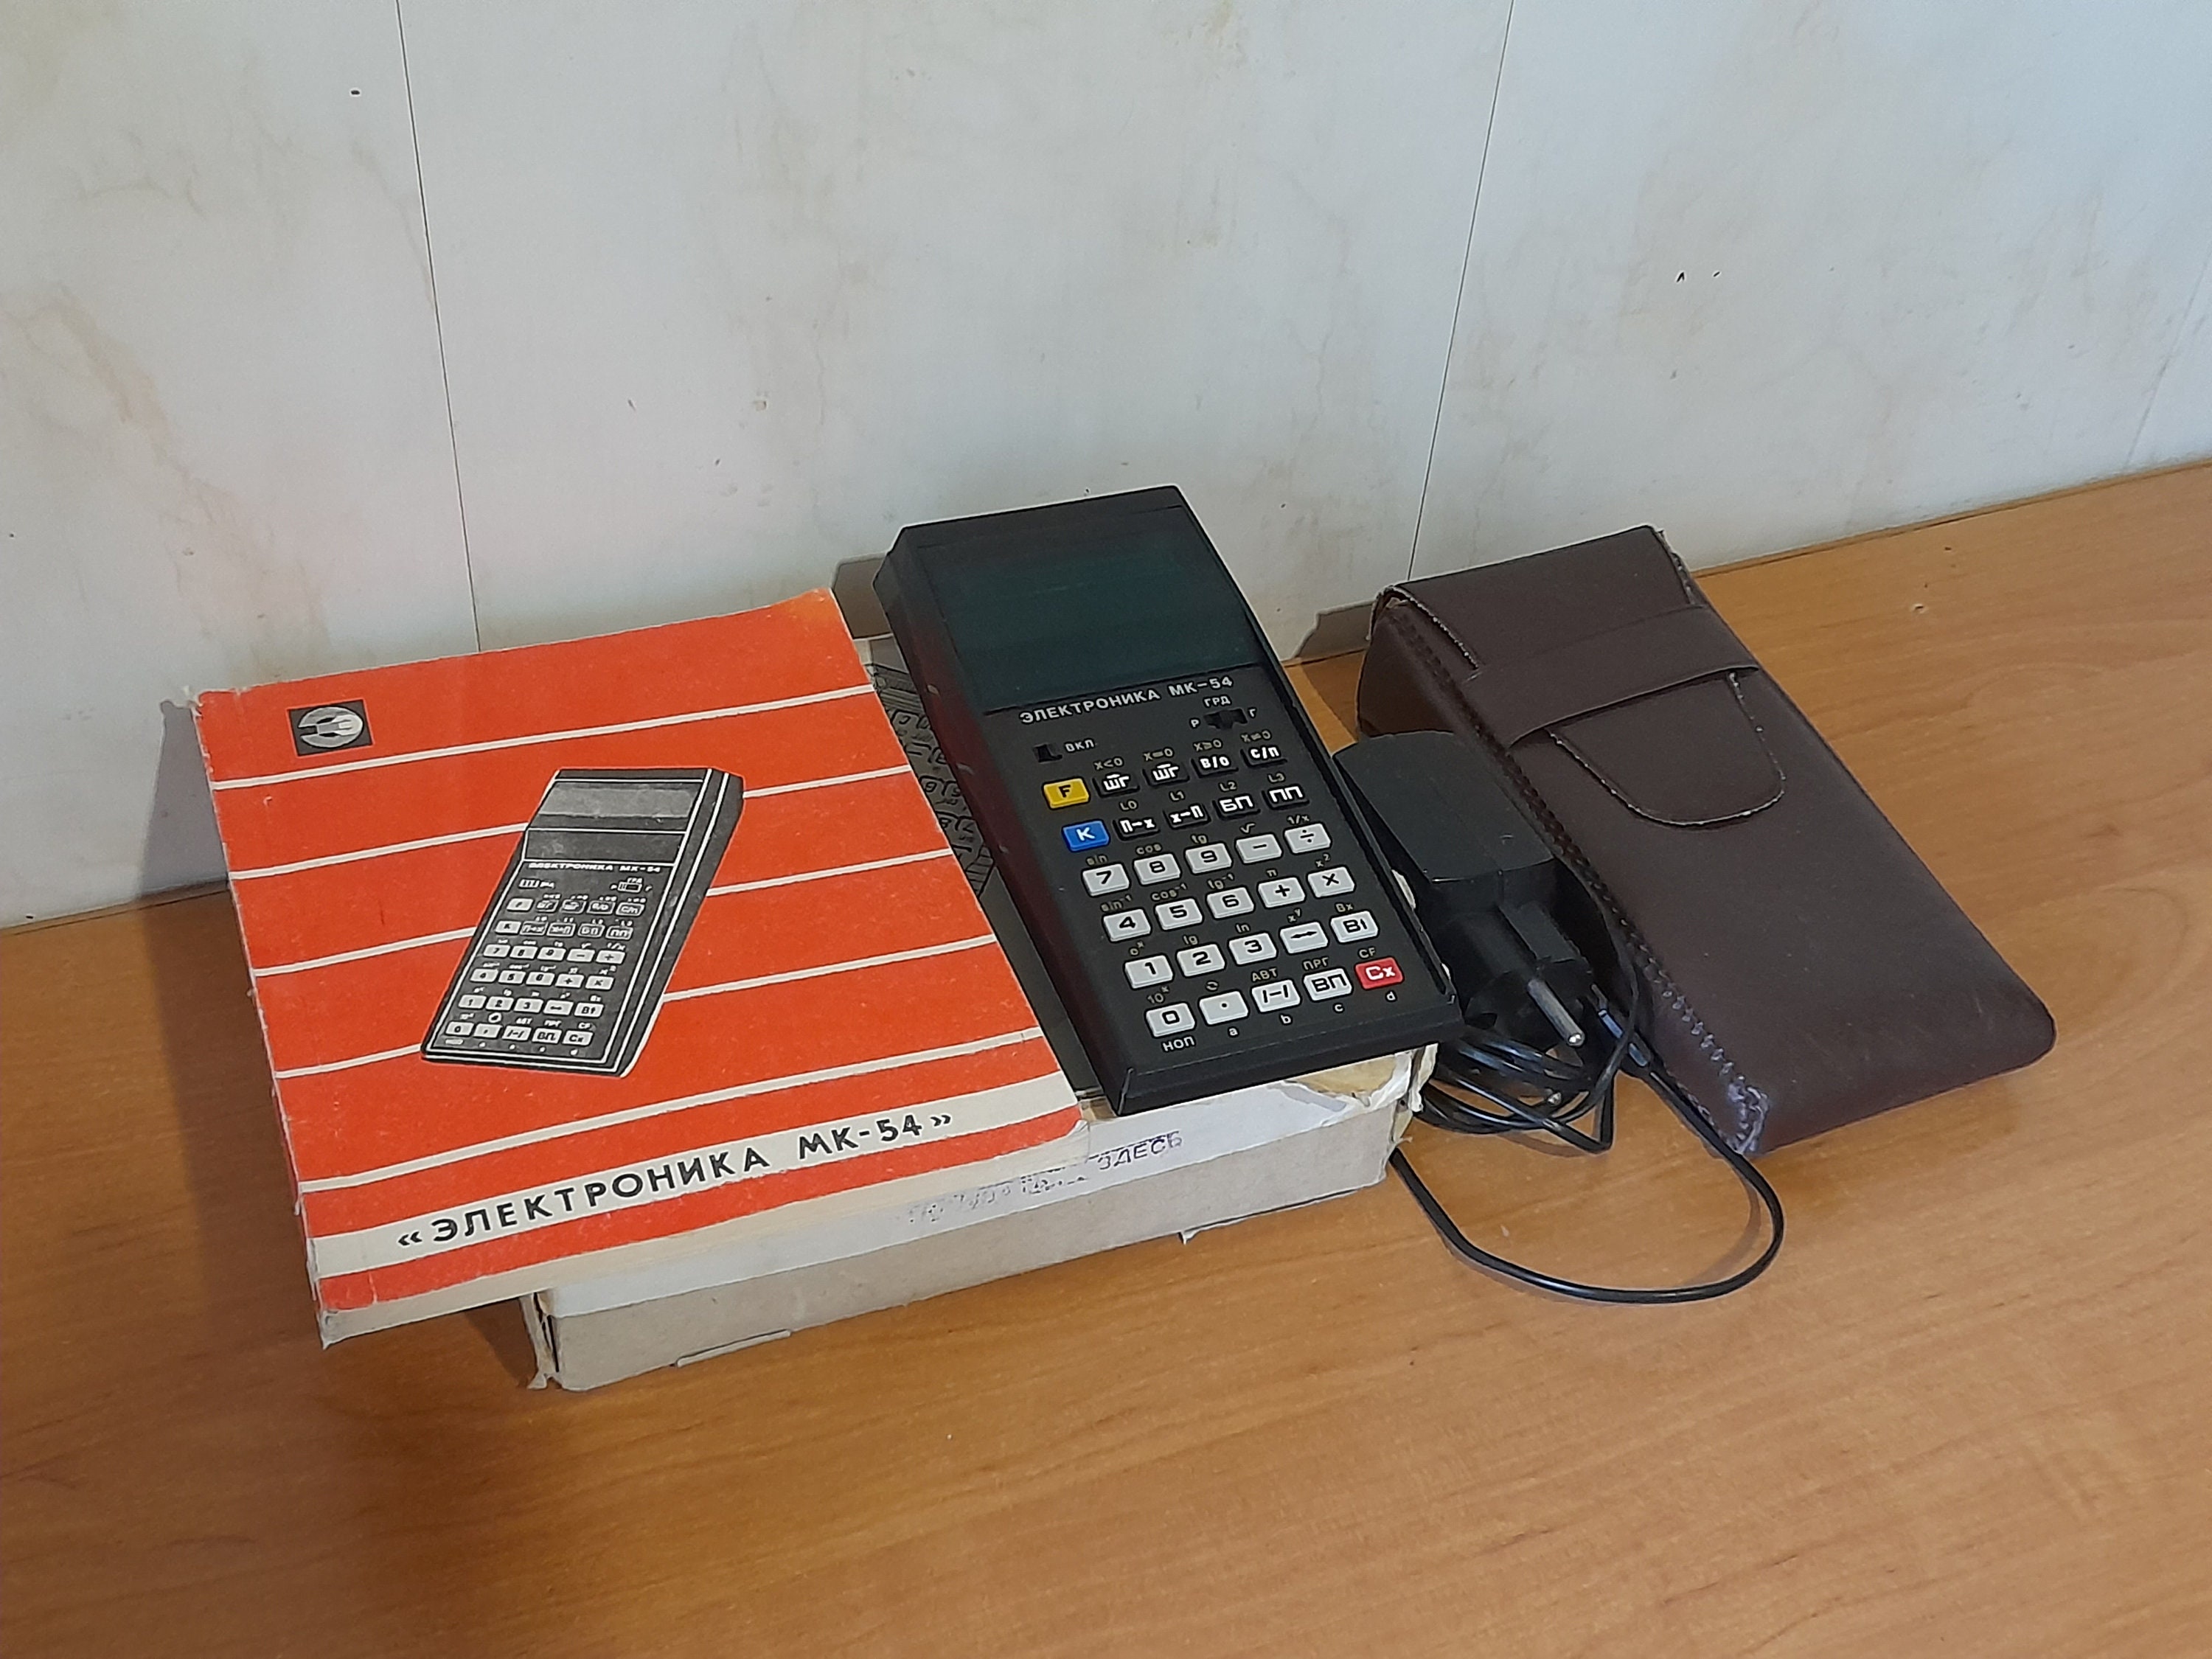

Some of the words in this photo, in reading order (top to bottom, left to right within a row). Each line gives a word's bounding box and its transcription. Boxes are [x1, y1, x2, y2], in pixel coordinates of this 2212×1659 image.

[1019, 689, 1161, 724] ЭЛЕКТРОНИКА
[1167, 675, 1234, 697] МК-54
[1203, 695, 1231, 708] ГРД
[1250, 746, 1280, 759] С/П
[1268, 772, 1286, 783] L3
[1058, 784, 1071, 799] F
[1219, 781, 1237, 792] L2
[1268, 785, 1304, 803] ПП
[1219, 795, 1254, 813] БП
[1076, 826, 1096, 842] К
[1135, 843, 1163, 855] cos
[1200, 849, 1218, 863] 9
[1148, 860, 1166, 874] 8
[1096, 869, 1113, 885] 7
[1221, 894, 1240, 908] 6
[1168, 904, 1189, 919] 5
[1118, 916, 1137, 929] 4
[1243, 939, 1263, 954] 3
[1358, 947, 1377, 959] CF
[1192, 950, 1211, 966] 2
[1302, 957, 1329, 971] ПРГ
[1144, 961, 1157, 975] 1
[1251, 967, 1278, 982] АВТ
[1311, 973, 1348, 992] ВП
[1386, 991, 1397, 1001] d
[1161, 1009, 1180, 1025] 0
[1279, 1014, 1292, 1025] b
[1228, 1027, 1239, 1037] a
[1162, 1035, 1195, 1051] НОП
